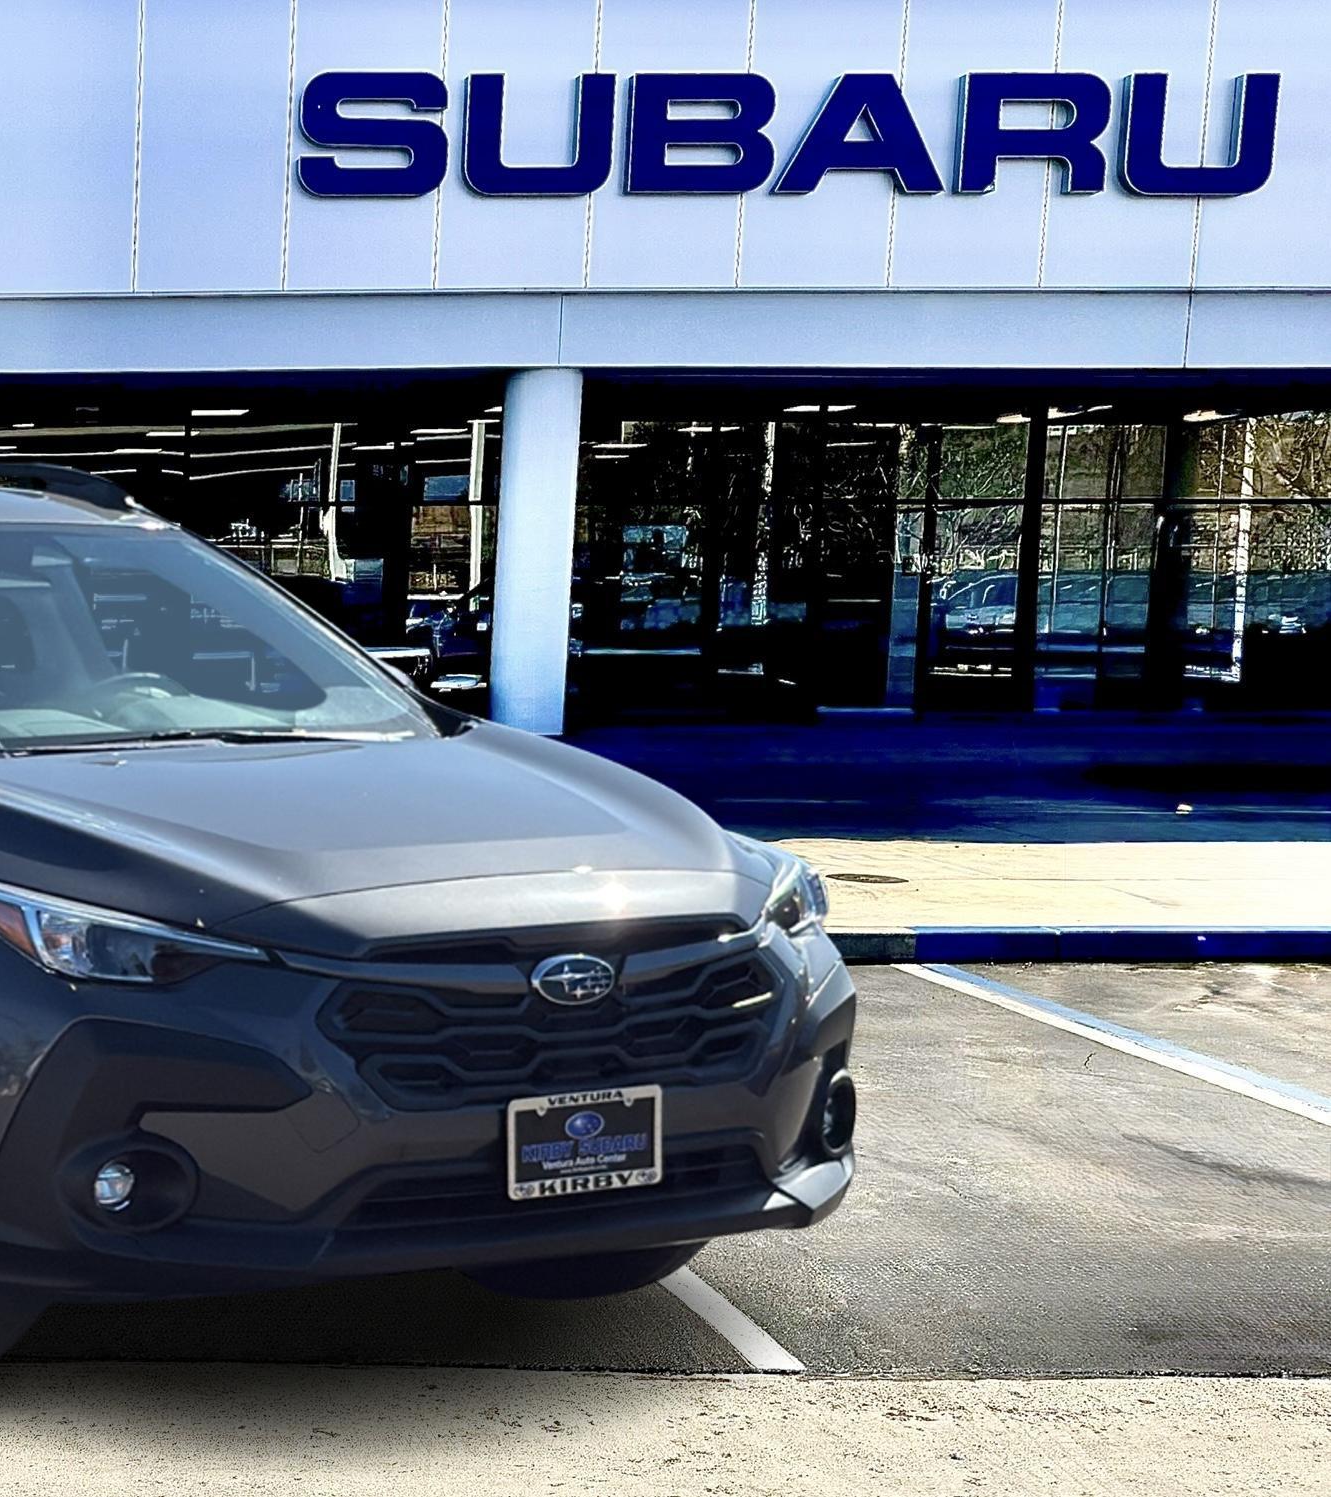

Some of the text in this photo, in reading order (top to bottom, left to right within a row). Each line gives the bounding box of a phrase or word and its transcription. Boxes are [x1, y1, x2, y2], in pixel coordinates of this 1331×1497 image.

[296, 70, 1282, 198] SUBARU
[547, 1090, 624, 1106] VENTURA
[521, 1133, 648, 1163] KIRBY SUBARU
[542, 1158, 573, 1171] Ventura
[574, 1155, 595, 1167] Auto
[597, 1153, 627, 1163] Center
[538, 1170, 634, 1196] KIRBY
